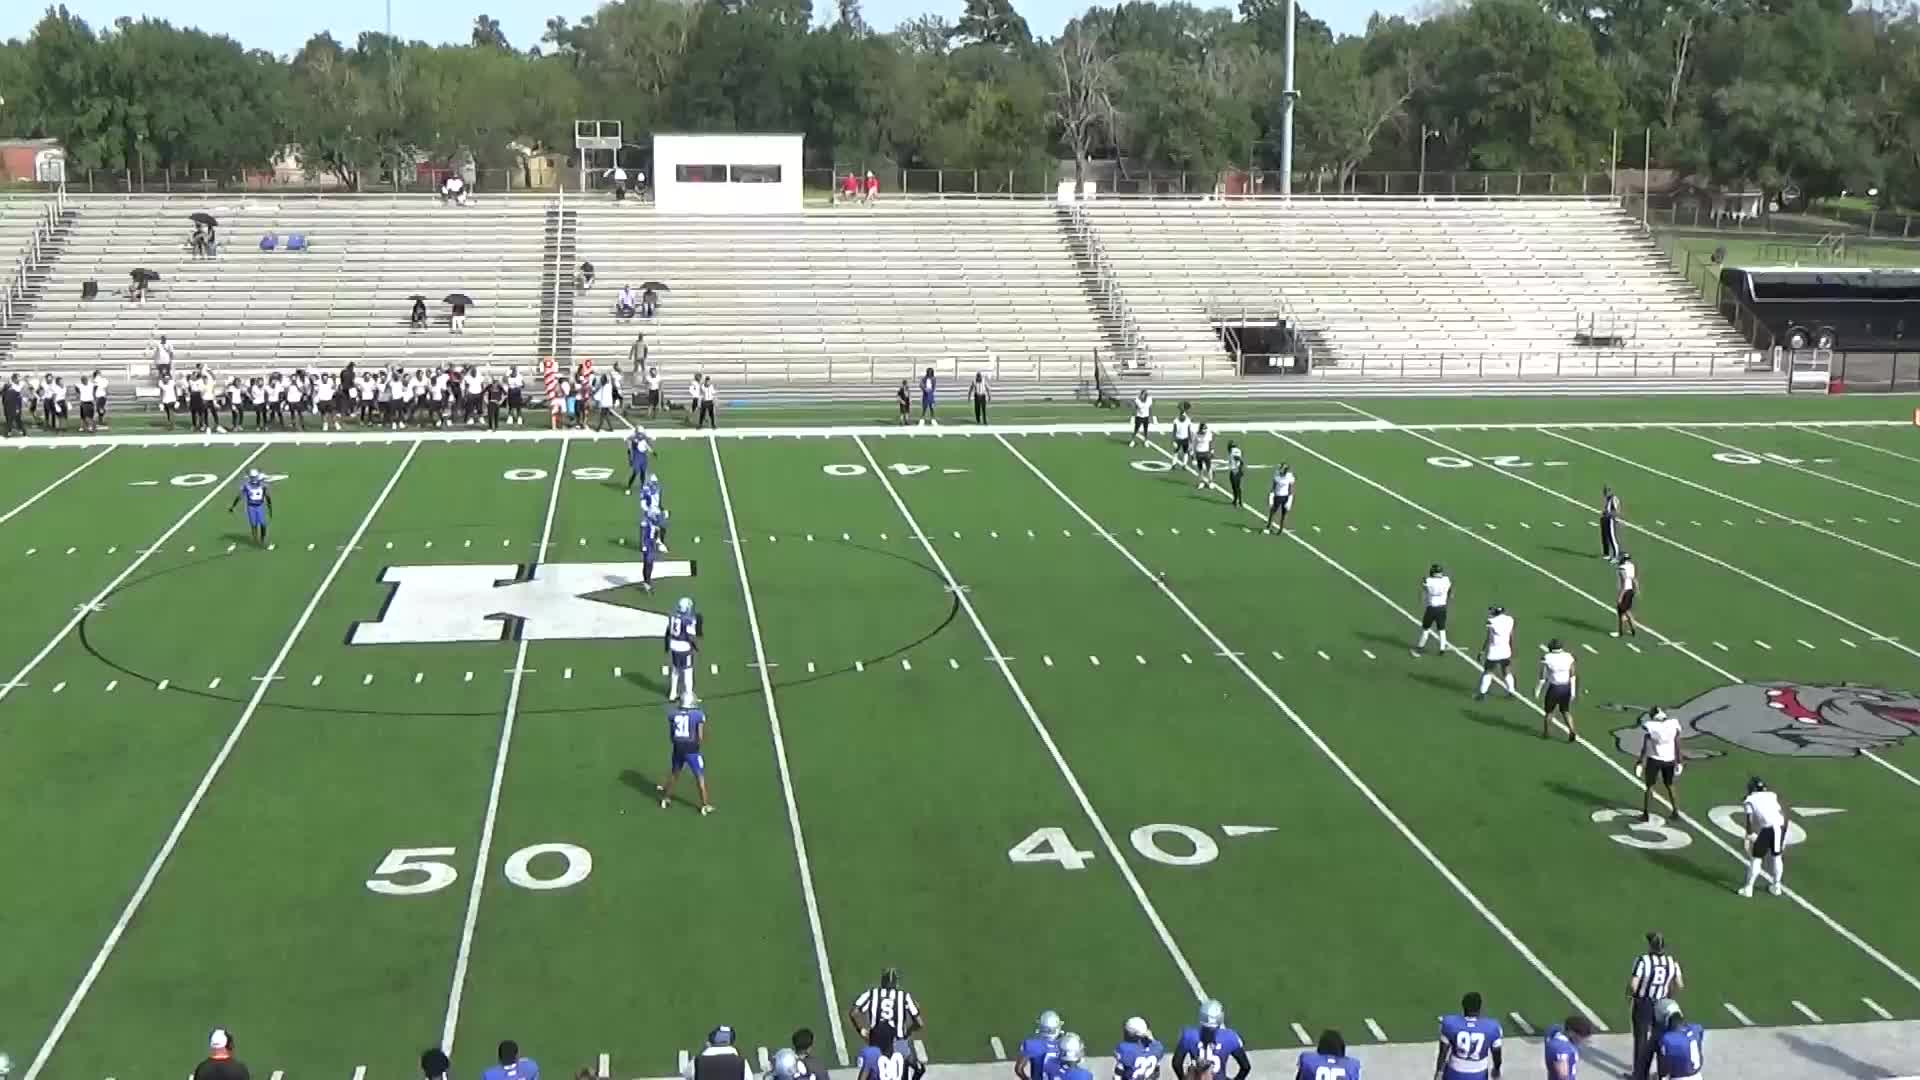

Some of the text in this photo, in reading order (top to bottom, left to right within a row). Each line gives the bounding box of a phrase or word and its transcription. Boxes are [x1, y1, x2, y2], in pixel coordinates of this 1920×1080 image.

[503, 466, 614, 481] 50
[823, 463, 931, 476] 40
[344, 560, 697, 646] K
[674, 715, 690, 737] 31
[1008, 823, 1219, 870] 40
[366, 843, 592, 895] 50
[1653, 966, 1667, 985] B
[880, 998, 895, 1020] S
[1456, 1031, 1485, 1059] 97
